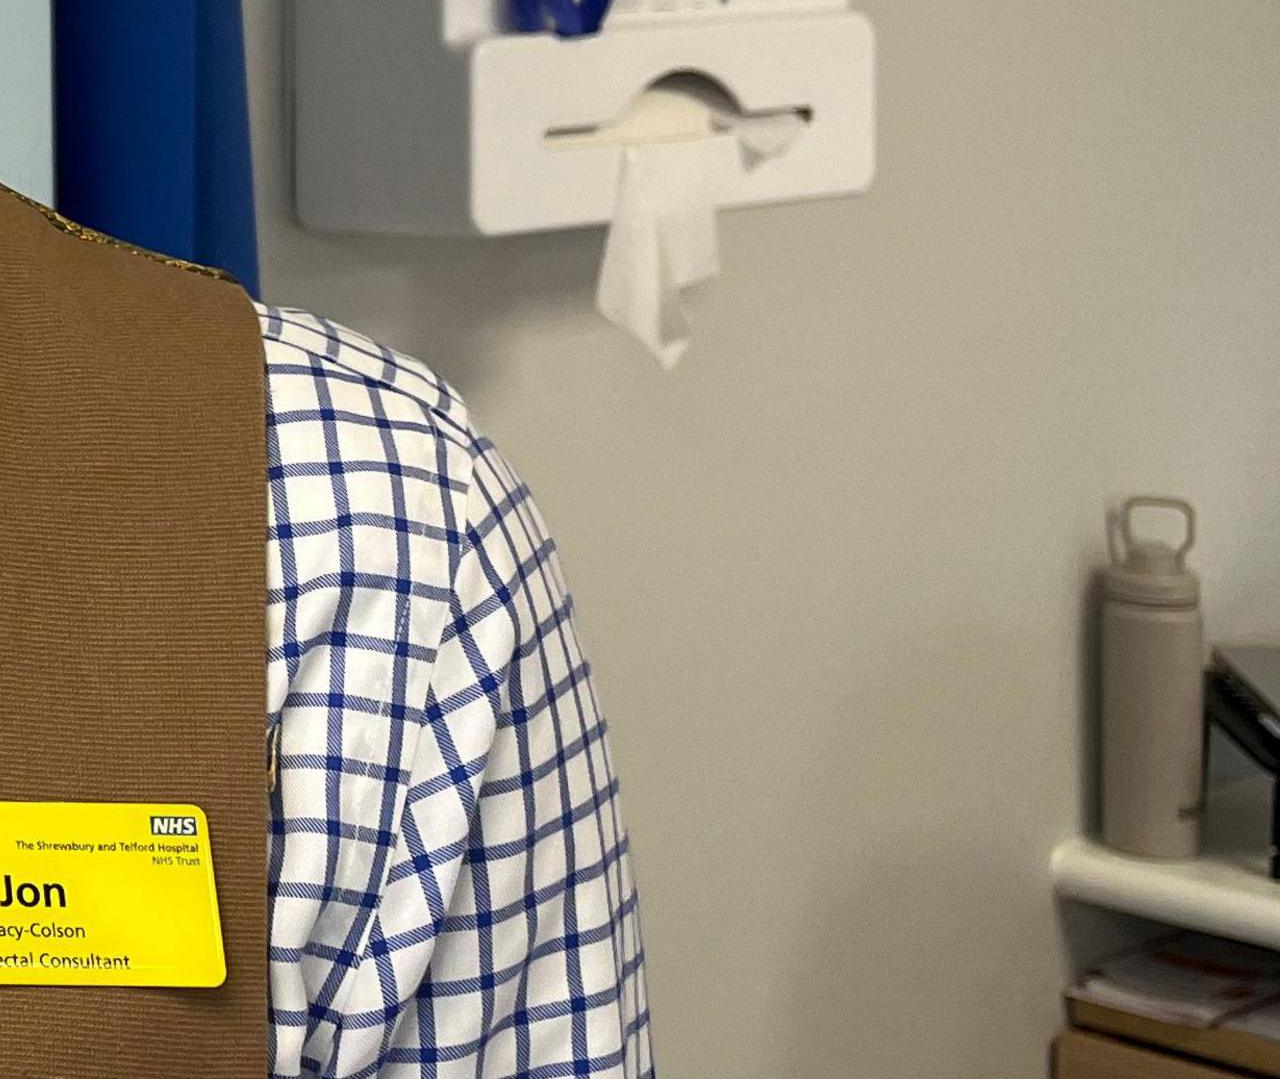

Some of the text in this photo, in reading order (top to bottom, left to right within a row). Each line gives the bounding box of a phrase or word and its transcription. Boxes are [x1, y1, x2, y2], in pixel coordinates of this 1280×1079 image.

[152, 817, 196, 834] NHS
[16, 840, 199, 854] The Shrewsbury and Telford Hospital
[152, 856, 200, 866] NHS Trust
[0, 874, 67, 908] Jon
[39, 953, 131, 970] Consultant
